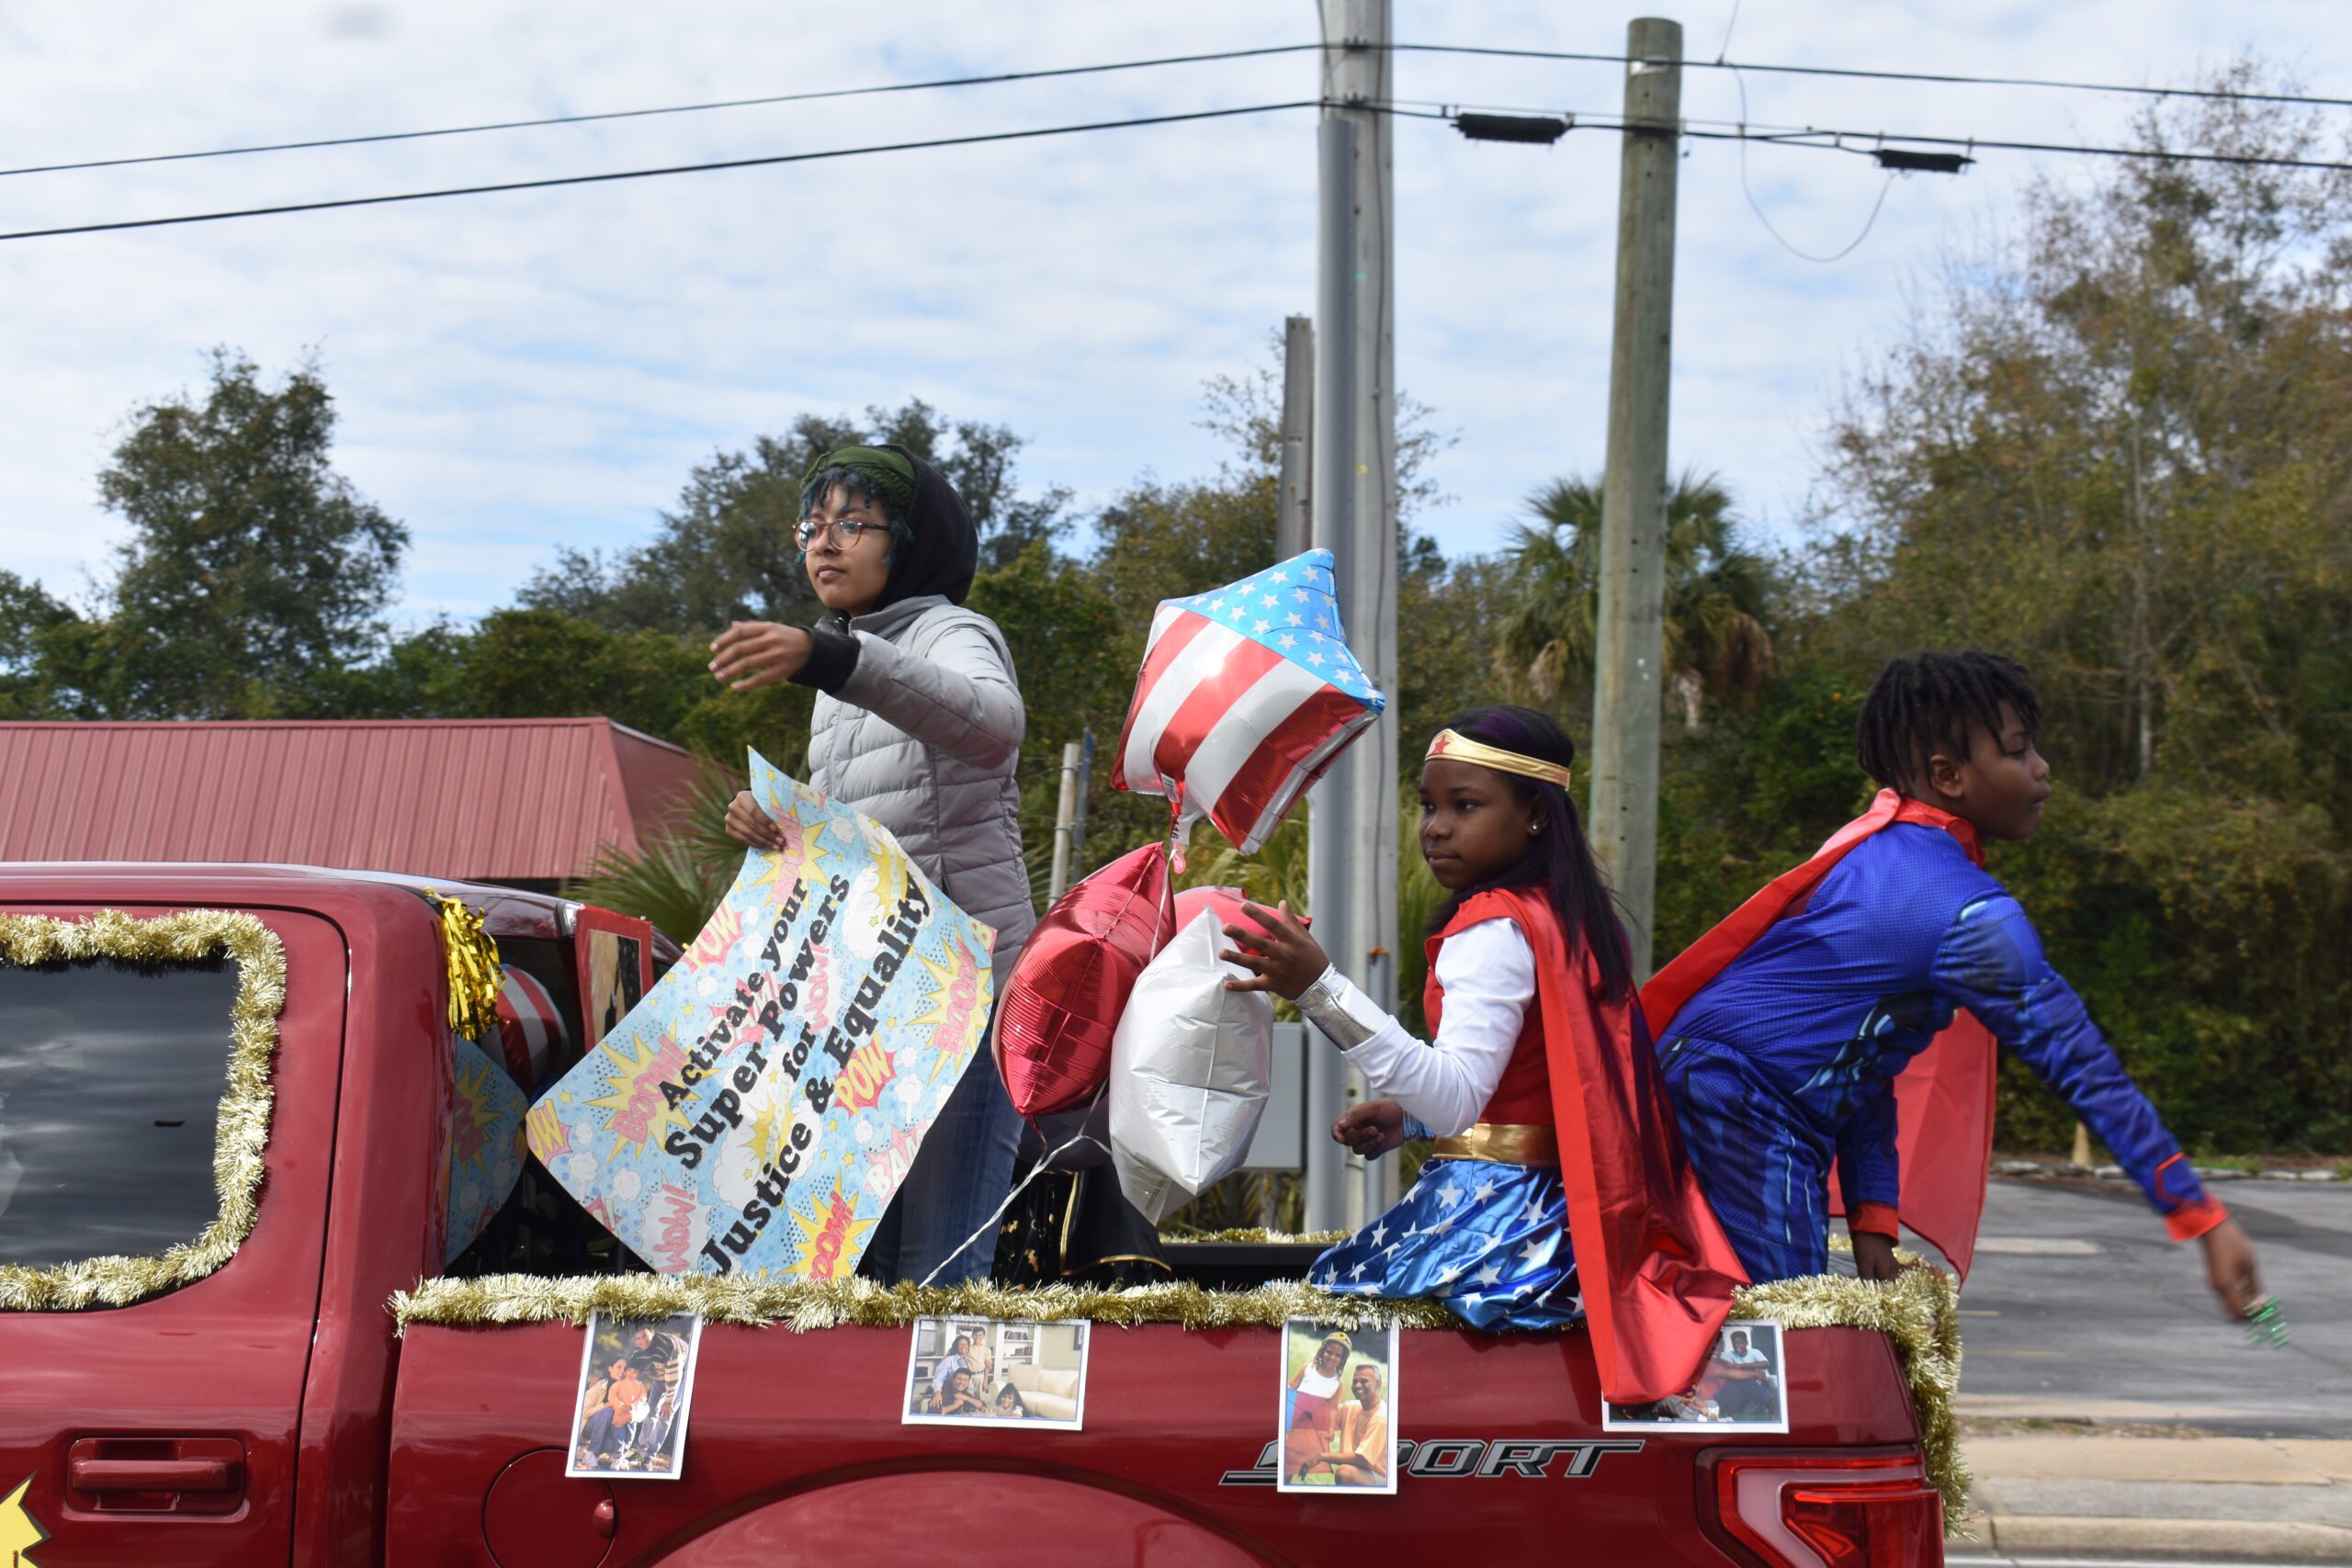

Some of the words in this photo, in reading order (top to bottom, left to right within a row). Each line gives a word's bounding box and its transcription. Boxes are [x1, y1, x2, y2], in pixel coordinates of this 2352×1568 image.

[659, 972, 764, 1111] Activate
[761, 877, 808, 972] your
[665, 1042, 767, 1169] Super
[758, 874, 850, 1042] Powers
[701, 1123, 812, 1277] Justice
[806, 1076, 835, 1114] &
[823, 869, 930, 1069] Equality
[783, 1021, 816, 1082] for
[835, 1032, 891, 1115] POW
[808, 1190, 854, 1283] OOM!
[1219, 1438, 1645, 1485] ORT
